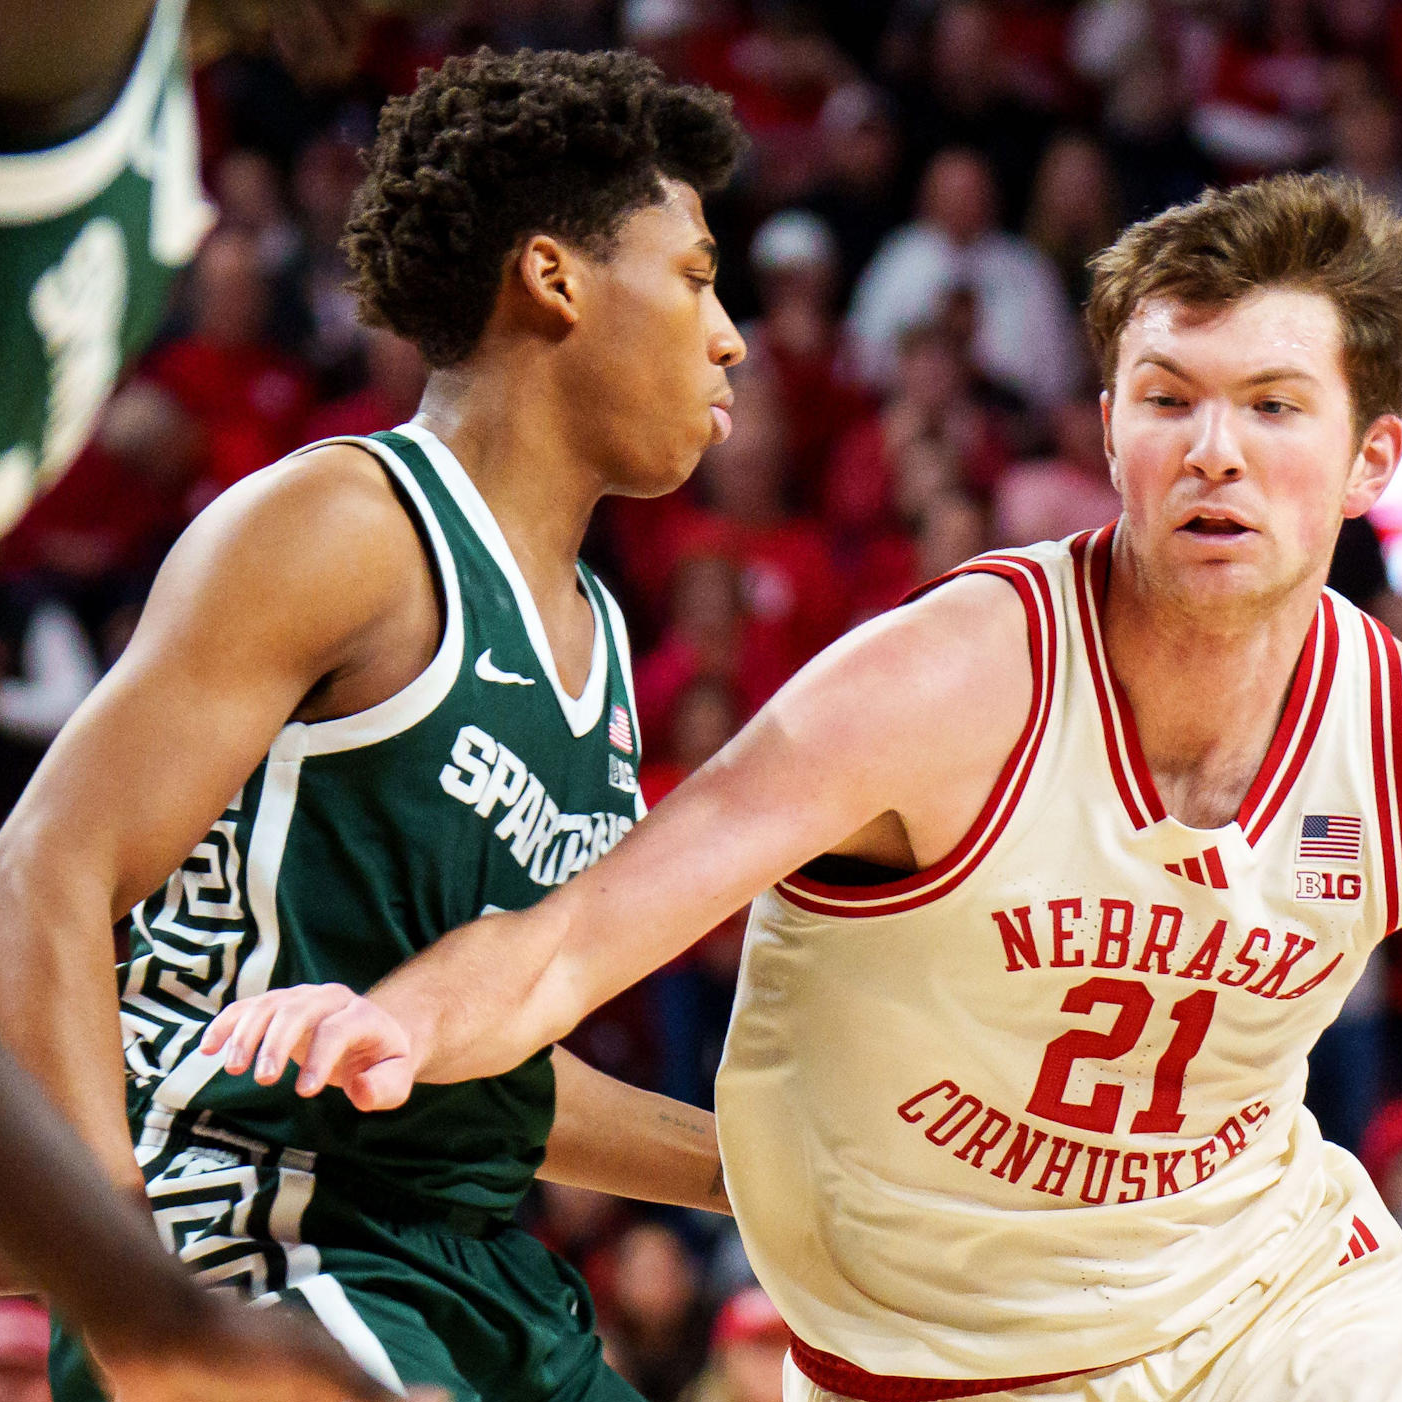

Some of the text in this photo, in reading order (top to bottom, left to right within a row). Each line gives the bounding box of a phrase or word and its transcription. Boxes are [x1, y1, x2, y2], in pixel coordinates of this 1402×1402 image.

[991, 897, 1345, 1000] NEBRASKA
[1025, 976, 1220, 1135] 21
[897, 1079, 1271, 1204] CORNHUSKERS
